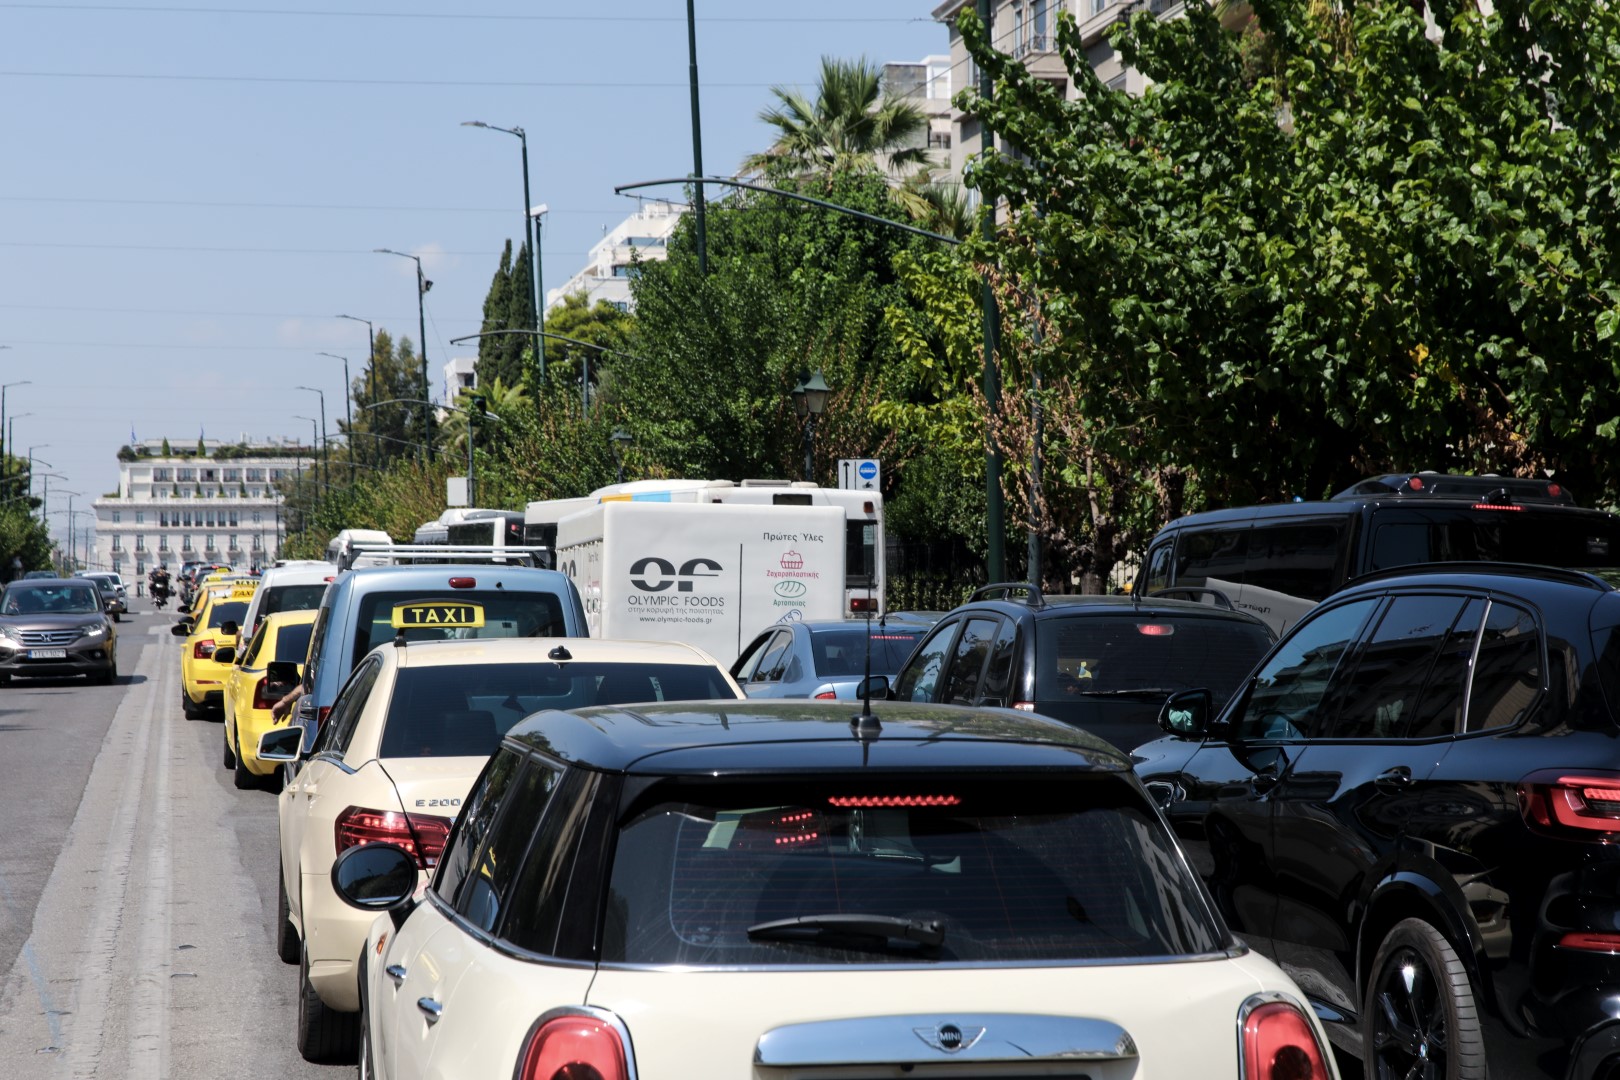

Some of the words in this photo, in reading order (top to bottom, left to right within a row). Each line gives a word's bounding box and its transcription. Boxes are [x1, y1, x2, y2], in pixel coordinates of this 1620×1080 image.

[763, 532, 798, 542] Πρώτες
[627, 595, 679, 605] OLYMPIC
[684, 596, 725, 606] FOODS
[411, 608, 467, 623] TAXI
[639, 616, 713, 624] www.olympic-foods.gr
[416, 799, 426, 807] E
[428, 799, 461, 807] 200
[940, 1032, 961, 1041] MINI
